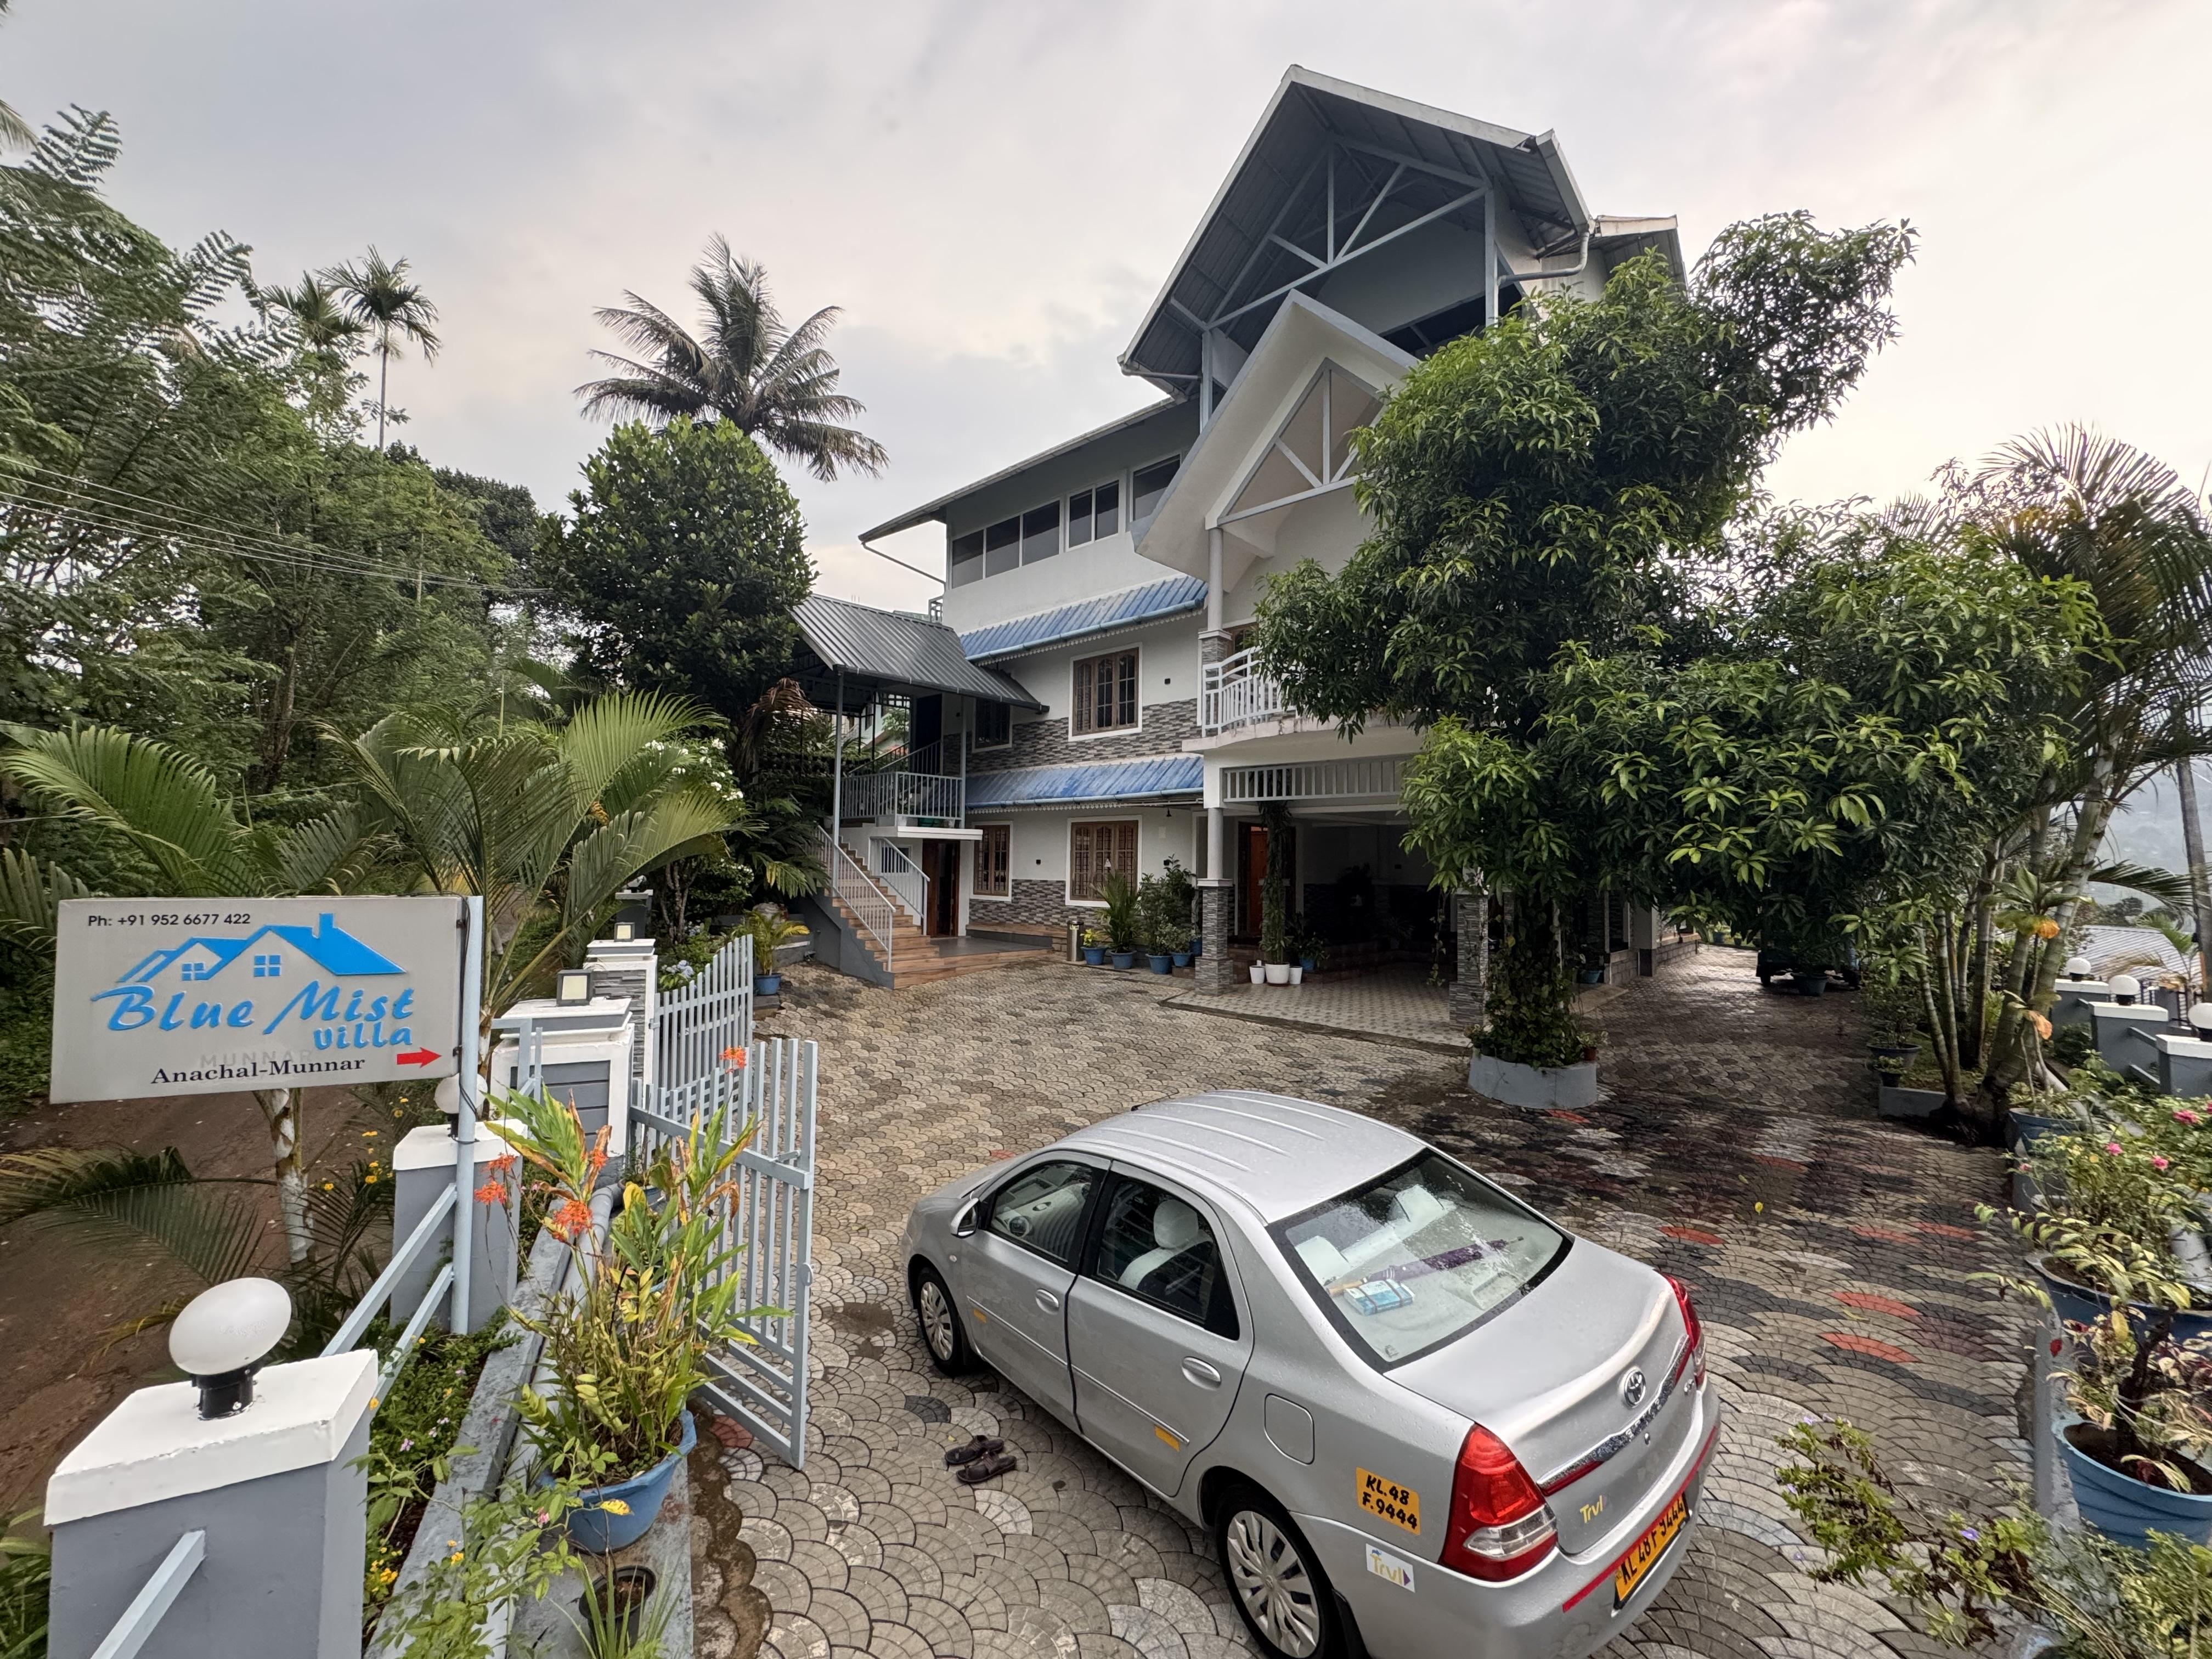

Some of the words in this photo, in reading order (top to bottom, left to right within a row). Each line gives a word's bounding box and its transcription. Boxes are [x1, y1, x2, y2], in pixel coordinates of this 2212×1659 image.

[88, 915, 112, 926] Ph:
[117, 915, 144, 926] +91
[151, 915, 179, 926] 952
[183, 914, 219, 925] 6677
[224, 913, 251, 924] 422
[90, 985, 255, 1031] Blue
[262, 980, 414, 1035] Mist
[150, 1057, 366, 1084] Anachal-Munnar
[1579, 1494, 1603, 1524] Trvl
[1370, 1553, 1403, 1585] Trvl
